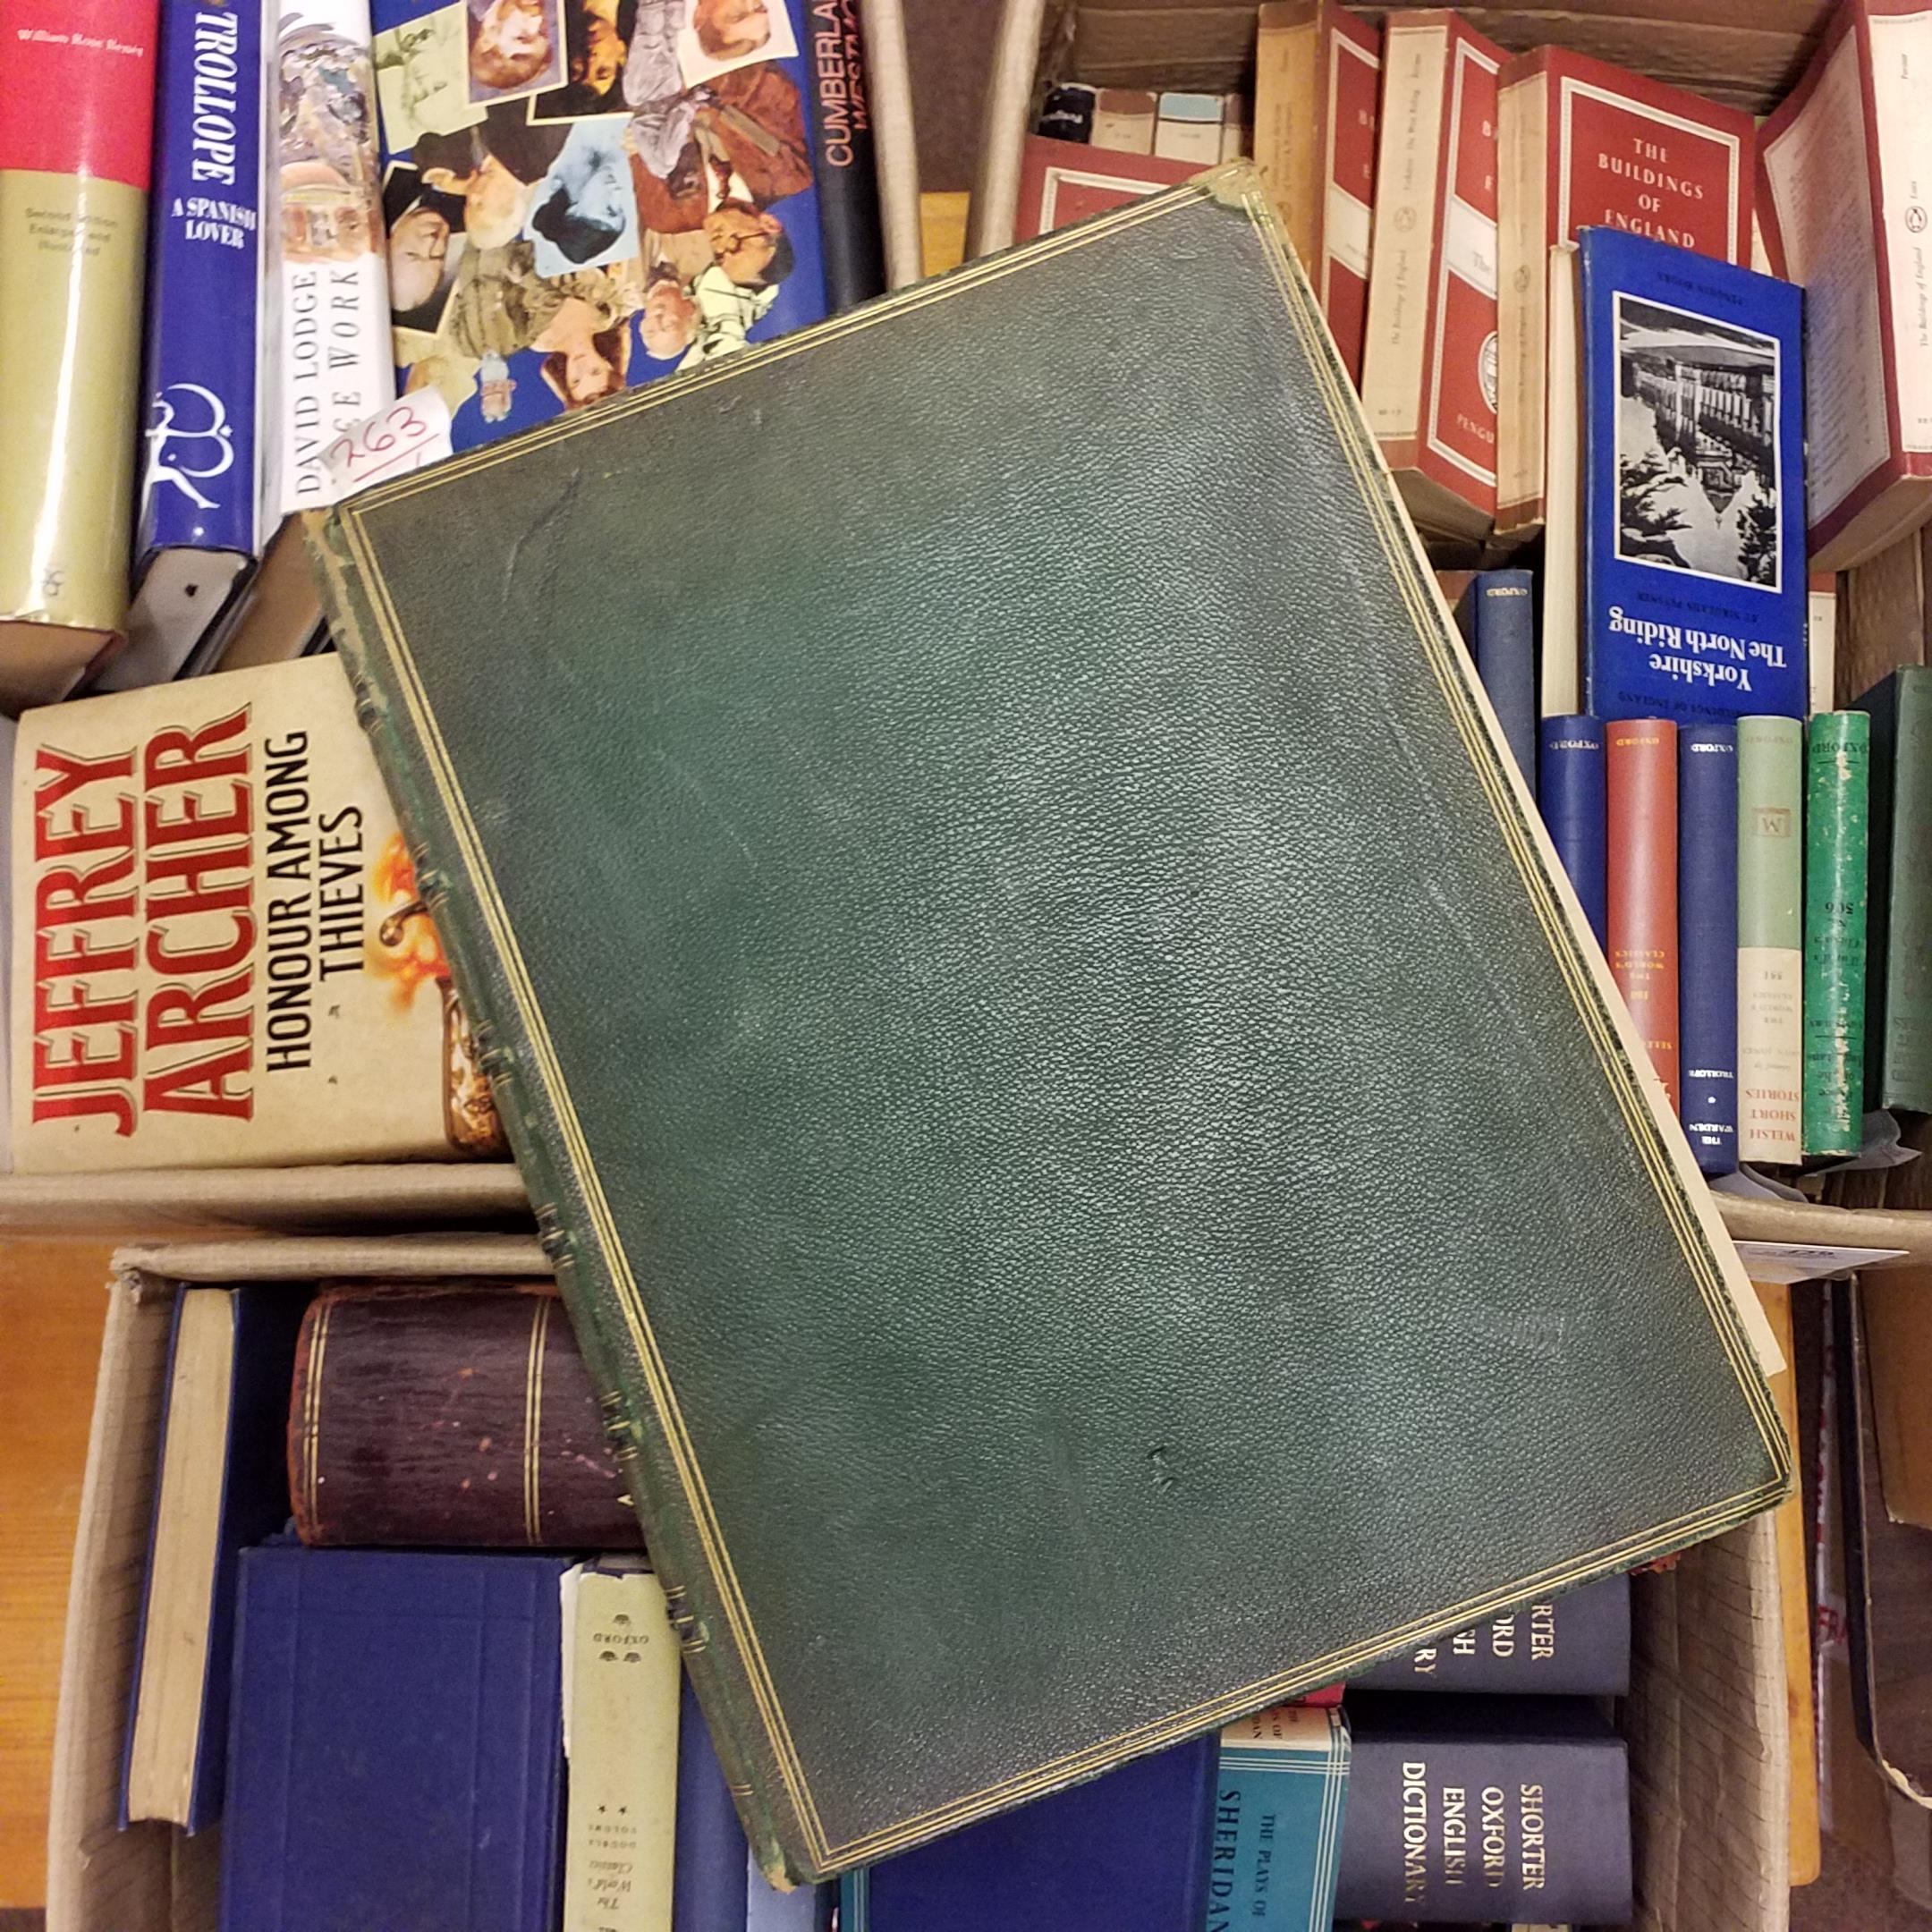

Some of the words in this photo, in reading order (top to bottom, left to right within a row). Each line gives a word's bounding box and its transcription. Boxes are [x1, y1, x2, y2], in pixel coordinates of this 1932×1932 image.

[191, 12, 239, 186] TROLLOPE
[1633, 138, 1669, 164] THE
[1598, 153, 1704, 199] BUILDINGS
[171, 198, 184, 217] A
[185, 198, 257, 231] SPANISH
[1638, 193, 1662, 213] OF
[184, 220, 244, 249] LOVER
[1604, 208, 1696, 249] ENGLAND
[292, 270, 319, 382] LODGE
[328, 270, 360, 369] WORK
[331, 391, 360, 433] CE
[292, 394, 321, 495] DAVID
[330, 405, 428, 468] 263
[1609, 606, 1682, 648] Riding
[1686, 628, 1746, 660] North
[1649, 653, 1752, 691] Yorkshire
[1749, 643, 1787, 668] The
[1549, 739, 1599, 750] OXFORD
[1615, 735, 1659, 747] OXFORD
[1691, 743, 1733, 754] OXFORD
[264, 730, 311, 881] AMONG
[143, 701, 255, 1123] ARCHER
[318, 806, 363, 982] THIEVES
[32, 743, 138, 1138] JEFFREY
[265, 891, 312, 1073] HONOUR
[1745, 1089, 1800, 1102] STORIES
[1750, 1109, 1796, 1122] SHORT
[1689, 1123, 1734, 1134] WARDEN
[1701, 1135, 1723, 1146] THE
[1749, 1129, 1796, 1142] WELSH
[592, 1631, 649, 1645] OXFORD
[1531, 1603, 1555, 1661] RTER
[1260, 1814, 1276, 1837] THE
[1402, 1762, 1428, 1903] DICTIONARY
[1443, 1787, 1467, 1885] ENGLISH
[1481, 1787, 1505, 1888] OXFORD
[1521, 1784, 1545, 1890] SHORTER
[1207, 1790, 1242, 1932] SHERIDAN
[1256, 1850, 1273, 1898] PLAYS
[1252, 1901, 1267, 1918] OF
